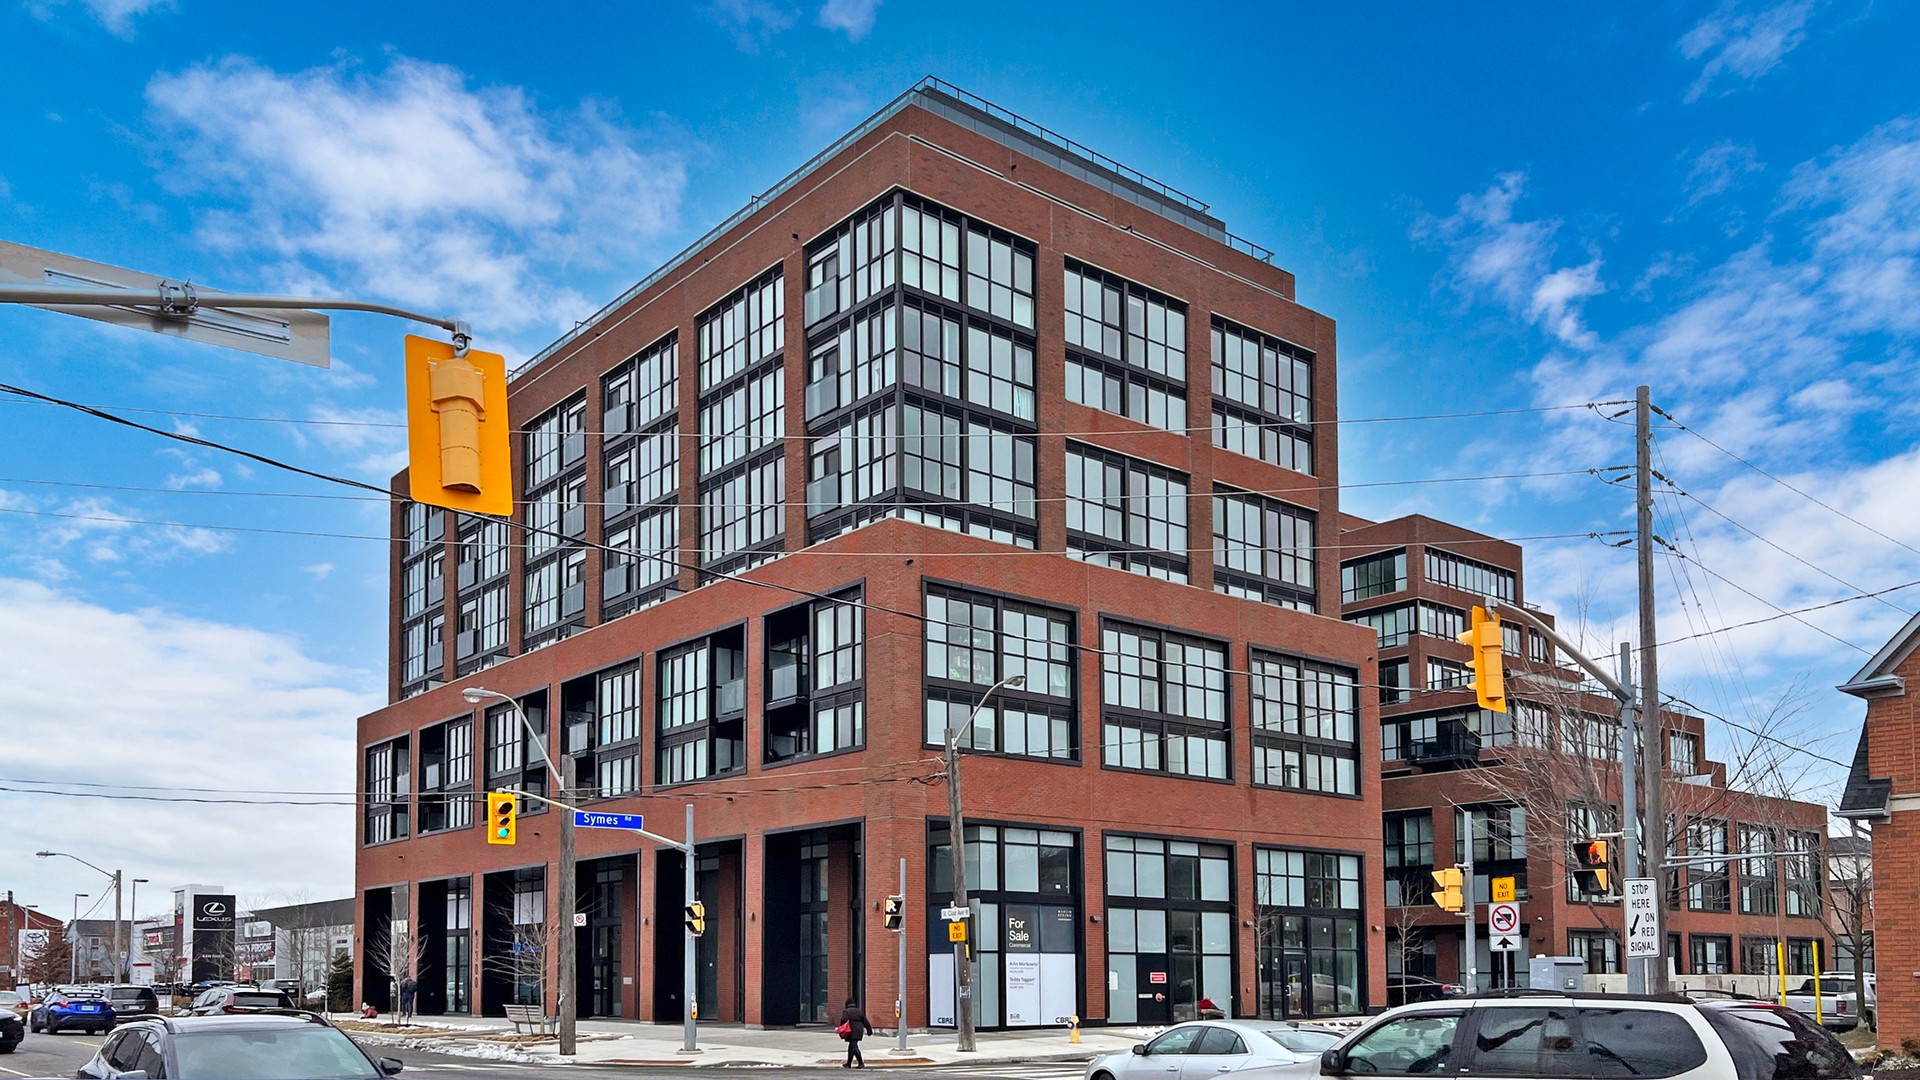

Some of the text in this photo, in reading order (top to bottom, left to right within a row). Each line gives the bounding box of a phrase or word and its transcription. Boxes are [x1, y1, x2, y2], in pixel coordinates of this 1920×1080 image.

[583, 813, 618, 826] Symes
[1631, 884, 1649, 895] STOP
[1631, 898, 1650, 909] HERE
[1009, 917, 1025, 929] For
[1645, 912, 1655, 923] ON
[1009, 930, 1030, 941] Sale
[1641, 926, 1656, 937] RED
[1630, 941, 1655, 952] SIGNAL
